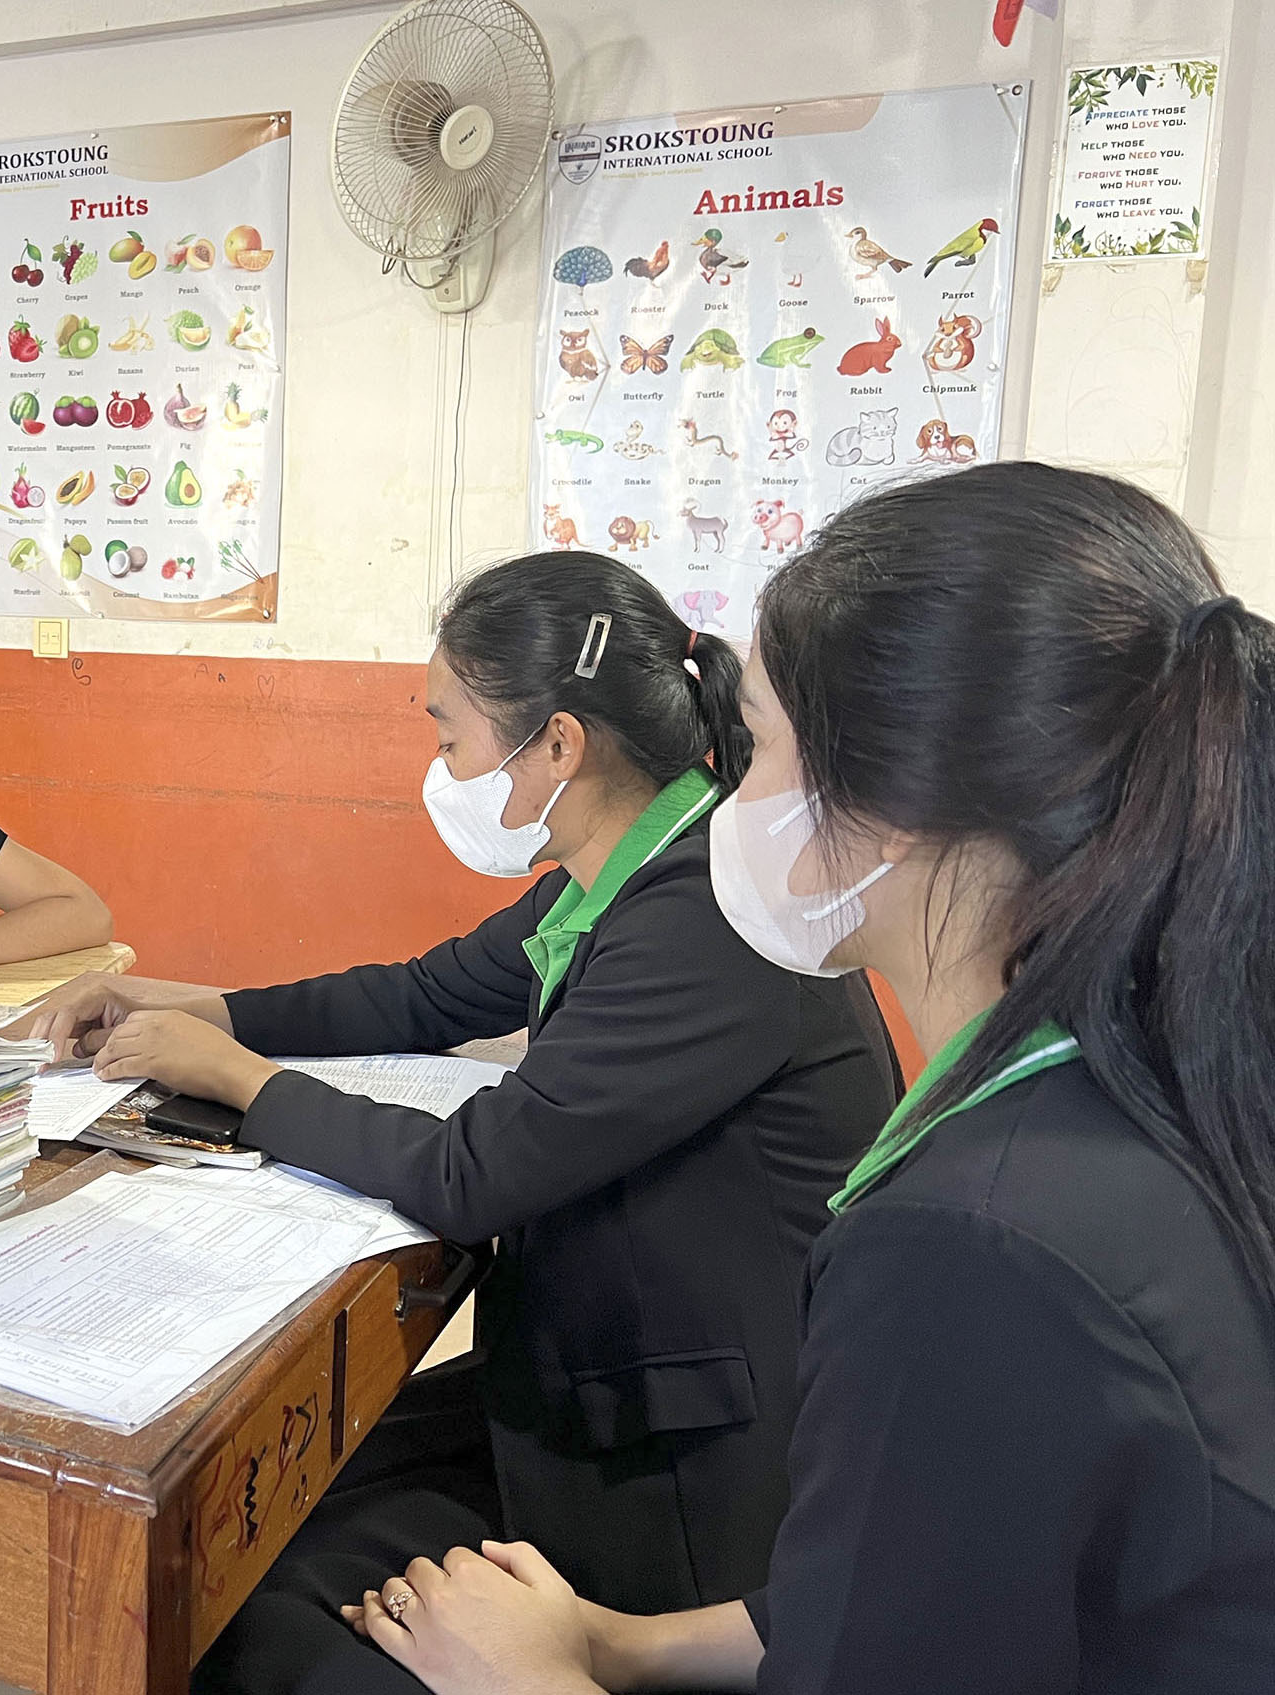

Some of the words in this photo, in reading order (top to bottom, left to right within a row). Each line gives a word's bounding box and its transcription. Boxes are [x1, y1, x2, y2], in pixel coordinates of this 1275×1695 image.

[1086, 109, 1149, 120] APPRECIATE
[1152, 106, 1186, 115] THOSE
[1106, 122, 1128, 131] WHO
[1132, 120, 1159, 129] LOVE
[1162, 119, 1186, 127] YOU.
[604, 121, 774, 154] SROKSTOUNG
[1081, 142, 1108, 150] HELP
[1111, 140, 1145, 148] THOSE
[603, 151, 713, 170] INTERNATIONAL
[717, 146, 772, 160] SCHOOL
[1128, 151, 1157, 160] NEED
[69, 166, 108, 178] SCHOOL
[1078, 170, 1122, 179] FORGIVE
[1125, 168, 1159, 176] THOSE
[1100, 182, 1122, 190] WHO
[1126, 180, 1154, 188] HURT
[693, 180, 844, 216] Animals
[1075, 200, 1115, 208] FORGET
[1119, 198, 1152, 206] THOSE
[70, 195, 149, 221] Fruits
[1123, 209, 1156, 217] LEAVE
[120, 290, 143, 298] Mango
[178, 287, 199, 295] Peach
[942, 291, 975, 300] Parrot
[854, 295, 896, 305] Sparrow
[704, 302, 728, 310] Duck
[564, 309, 599, 317] Peacock
[10, 371, 46, 379] Strawberry
[68, 369, 83, 377] Kiwi
[776, 389, 797, 397] Frog
[850, 387, 883, 395] Rabbit
[922, 384, 977, 394] Chipmunk
[623, 392, 663, 402] Butterfly
[696, 391, 724, 399] Turtle
[688, 478, 721, 486] Dragon
[762, 477, 799, 486] Monkey
[850, 477, 867, 485] Cat
